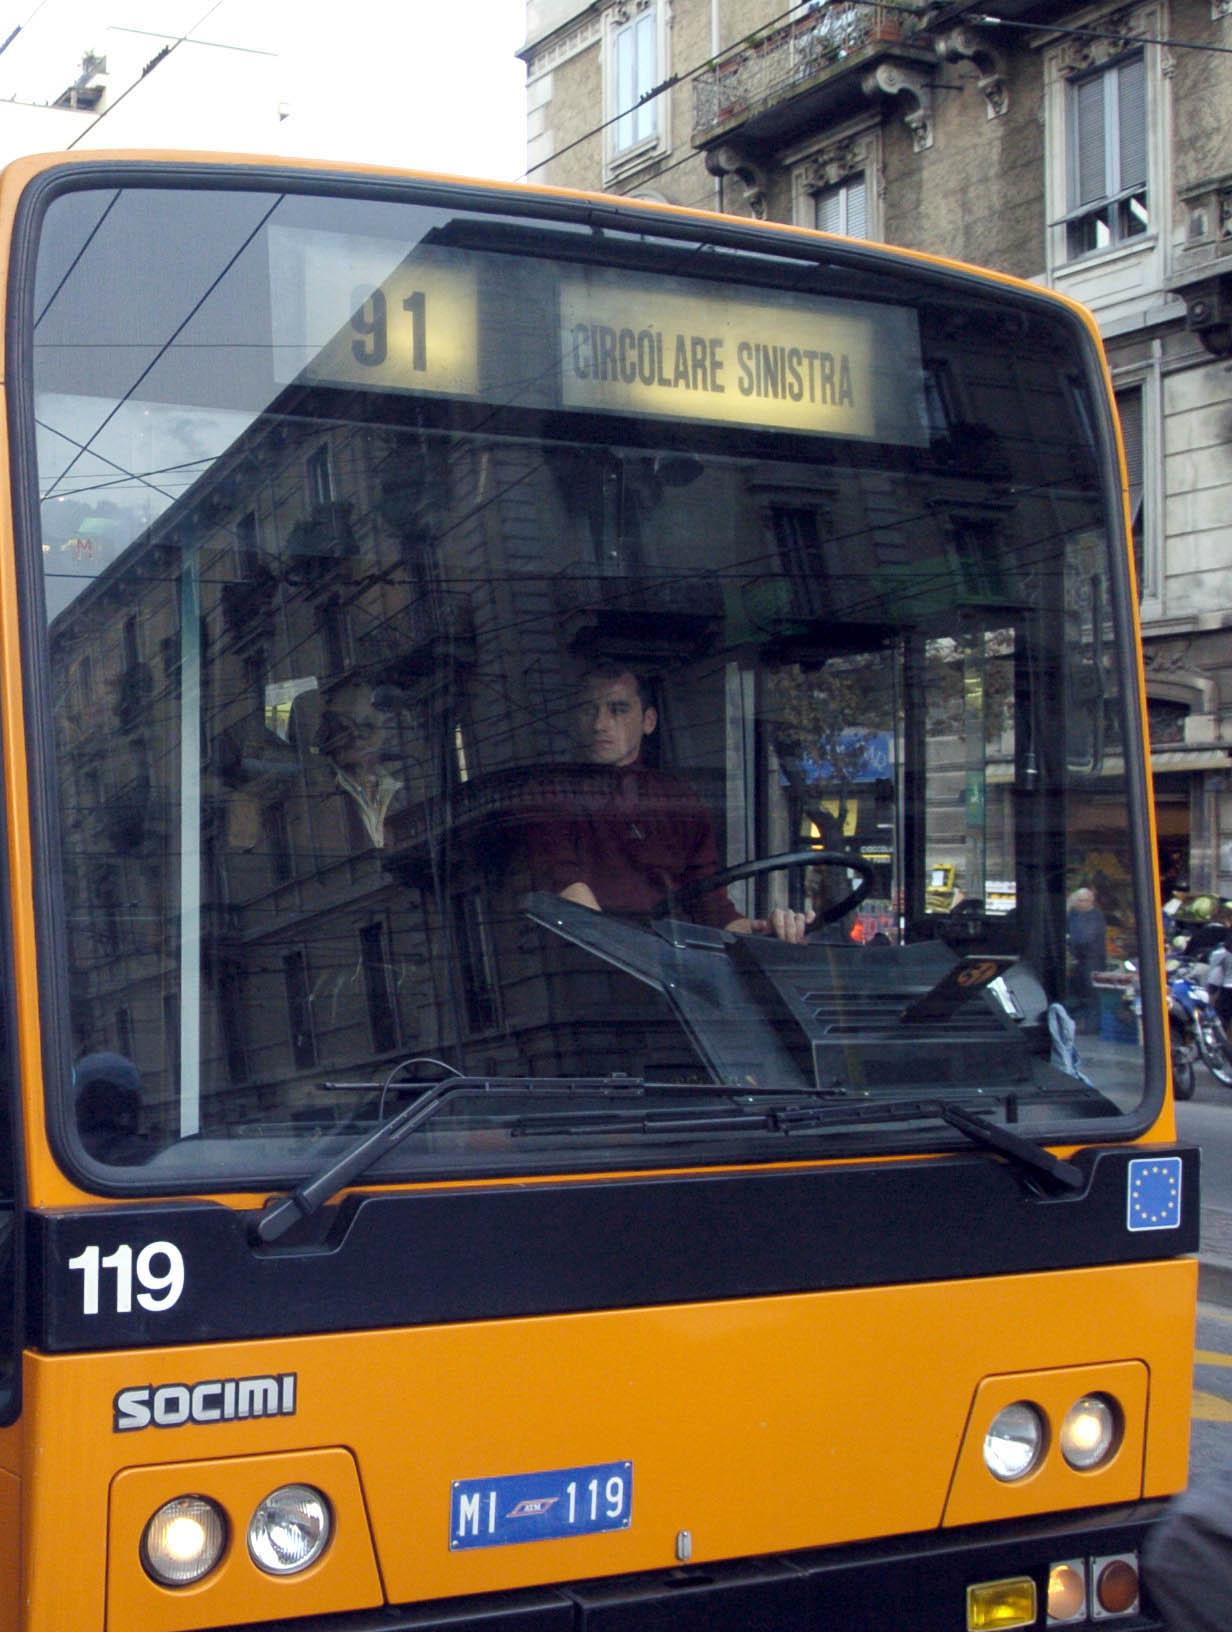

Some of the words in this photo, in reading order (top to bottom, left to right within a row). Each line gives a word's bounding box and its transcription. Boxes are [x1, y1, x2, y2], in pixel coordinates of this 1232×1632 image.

[350, 285, 426, 371] 91
[572, 323, 725, 393] CIRCOLARE
[737, 341, 854, 408] SINISTRA
[68, 1241, 185, 1315] 119
[113, 1373, 297, 1433] SOCIMI
[459, 1491, 496, 1537] MI
[566, 1476, 624, 1523] 119
